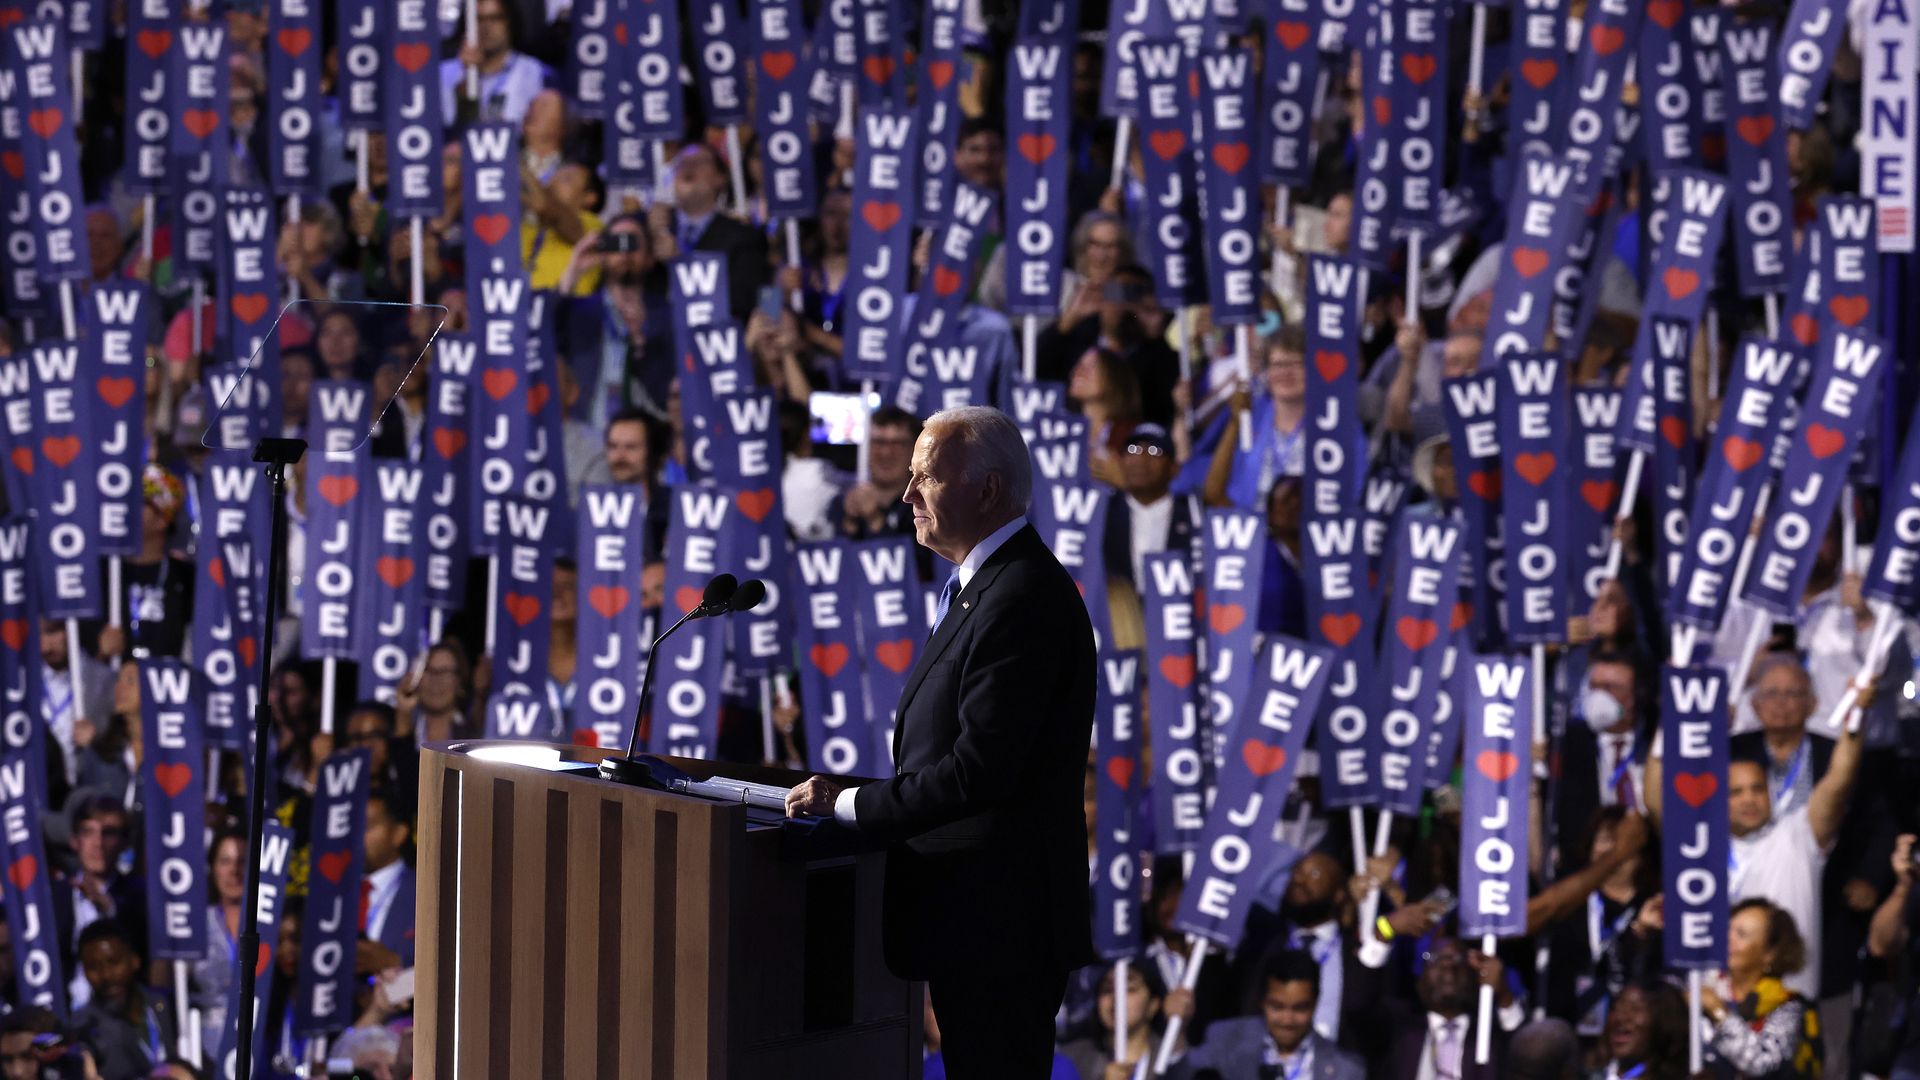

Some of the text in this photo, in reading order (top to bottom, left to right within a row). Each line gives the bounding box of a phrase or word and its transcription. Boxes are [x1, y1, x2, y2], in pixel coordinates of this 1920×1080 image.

[181, 27, 222, 97] WE
[347, 6, 378, 113] JOE
[638, 13, 670, 124] JOE
[703, 3, 739, 108] JOE
[1015, 46, 1060, 121] WE
[1139, 45, 1180, 119] WE
[1205, 54, 1246, 130] WE
[1656, 42, 1691, 158] JOE
[1780, 7, 1831, 109] JOE
[1873, 0, 1908, 196] AINE
[14, 24, 55, 97] WE
[40, 152, 75, 262] JOE
[136, 70, 169, 177] JOE
[280, 68, 311, 177] JOE
[398, 85, 431, 199] JOE
[466, 128, 510, 202] WE
[769, 92, 801, 201] JOE
[924, 101, 946, 212] JOE
[1272, 62, 1303, 170] JOE
[1401, 97, 1433, 209] JOE
[1725, 27, 1783, 275] WE JOE
[9, 193, 38, 300] JOE
[183, 152, 216, 260] JOE
[226, 208, 268, 281] WE
[857, 115, 911, 360] WE JOE
[944, 183, 990, 262] WE
[1018, 177, 1053, 295] JOE
[1219, 187, 1254, 305] JOE
[1359, 139, 1388, 251] JOE
[1524, 160, 1572, 237] WE
[1676, 176, 1725, 257] WE
[1826, 205, 1871, 279] WE
[482, 278, 522, 355] WE
[95, 289, 140, 537] WE JOE
[1313, 260, 1352, 514] WE JOE
[1450, 377, 1500, 458] WE
[1737, 343, 1793, 426] WE
[1822, 333, 1881, 417] WE
[34, 347, 85, 599] WE JOE
[428, 338, 476, 588] WE JOE
[524, 429, 556, 500] JO
[726, 396, 771, 477] WE
[1576, 393, 1621, 468] WE
[316, 388, 364, 638] WE JOE
[378, 467, 422, 543] WE
[507, 501, 548, 582] WE
[587, 492, 634, 571] WE
[680, 492, 729, 573] WE
[1052, 486, 1099, 566] WE
[1508, 359, 1558, 623] WE JOE
[1761, 472, 1823, 591] JOE
[859, 547, 908, 627] WE
[1211, 515, 1259, 590] WE
[1408, 522, 1458, 605] WE
[1687, 487, 1744, 607] JOE
[5, 665, 31, 746] JO
[799, 548, 858, 774] WE JO
[1307, 518, 1367, 785] WE JOE
[1475, 662, 1525, 739] WE
[1166, 703, 1204, 829] JOE
[1197, 643, 1322, 919] WE JOE
[1380, 666, 1422, 790] JOE
[147, 668, 193, 938] WE JOE
[1475, 797, 1514, 916] JOE
[1670, 675, 1720, 948] WE JOE
[312, 758, 362, 1017] WE JOE
